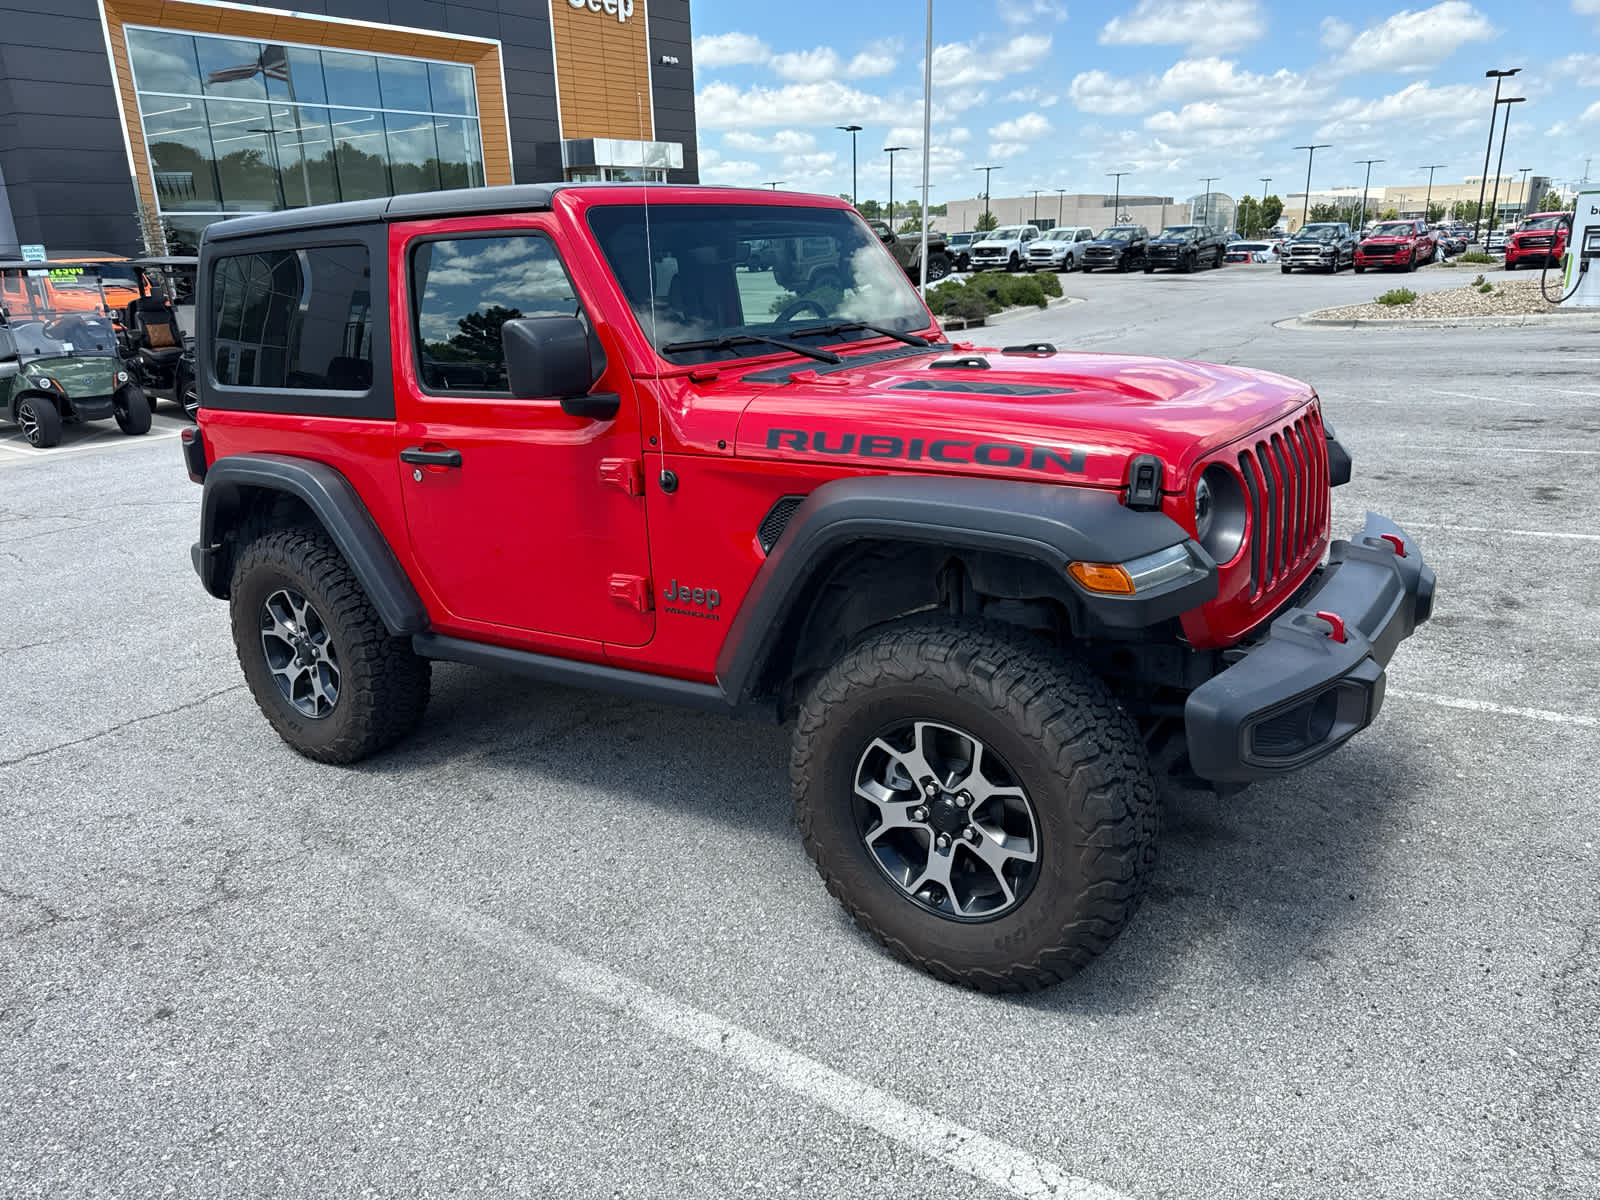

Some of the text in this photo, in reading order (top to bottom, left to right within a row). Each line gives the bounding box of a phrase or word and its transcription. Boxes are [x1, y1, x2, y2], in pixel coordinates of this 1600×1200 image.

[766, 428, 1087, 473] RUBICON
[663, 578, 720, 610] Jeep
[664, 605, 720, 621] WRANGLER
